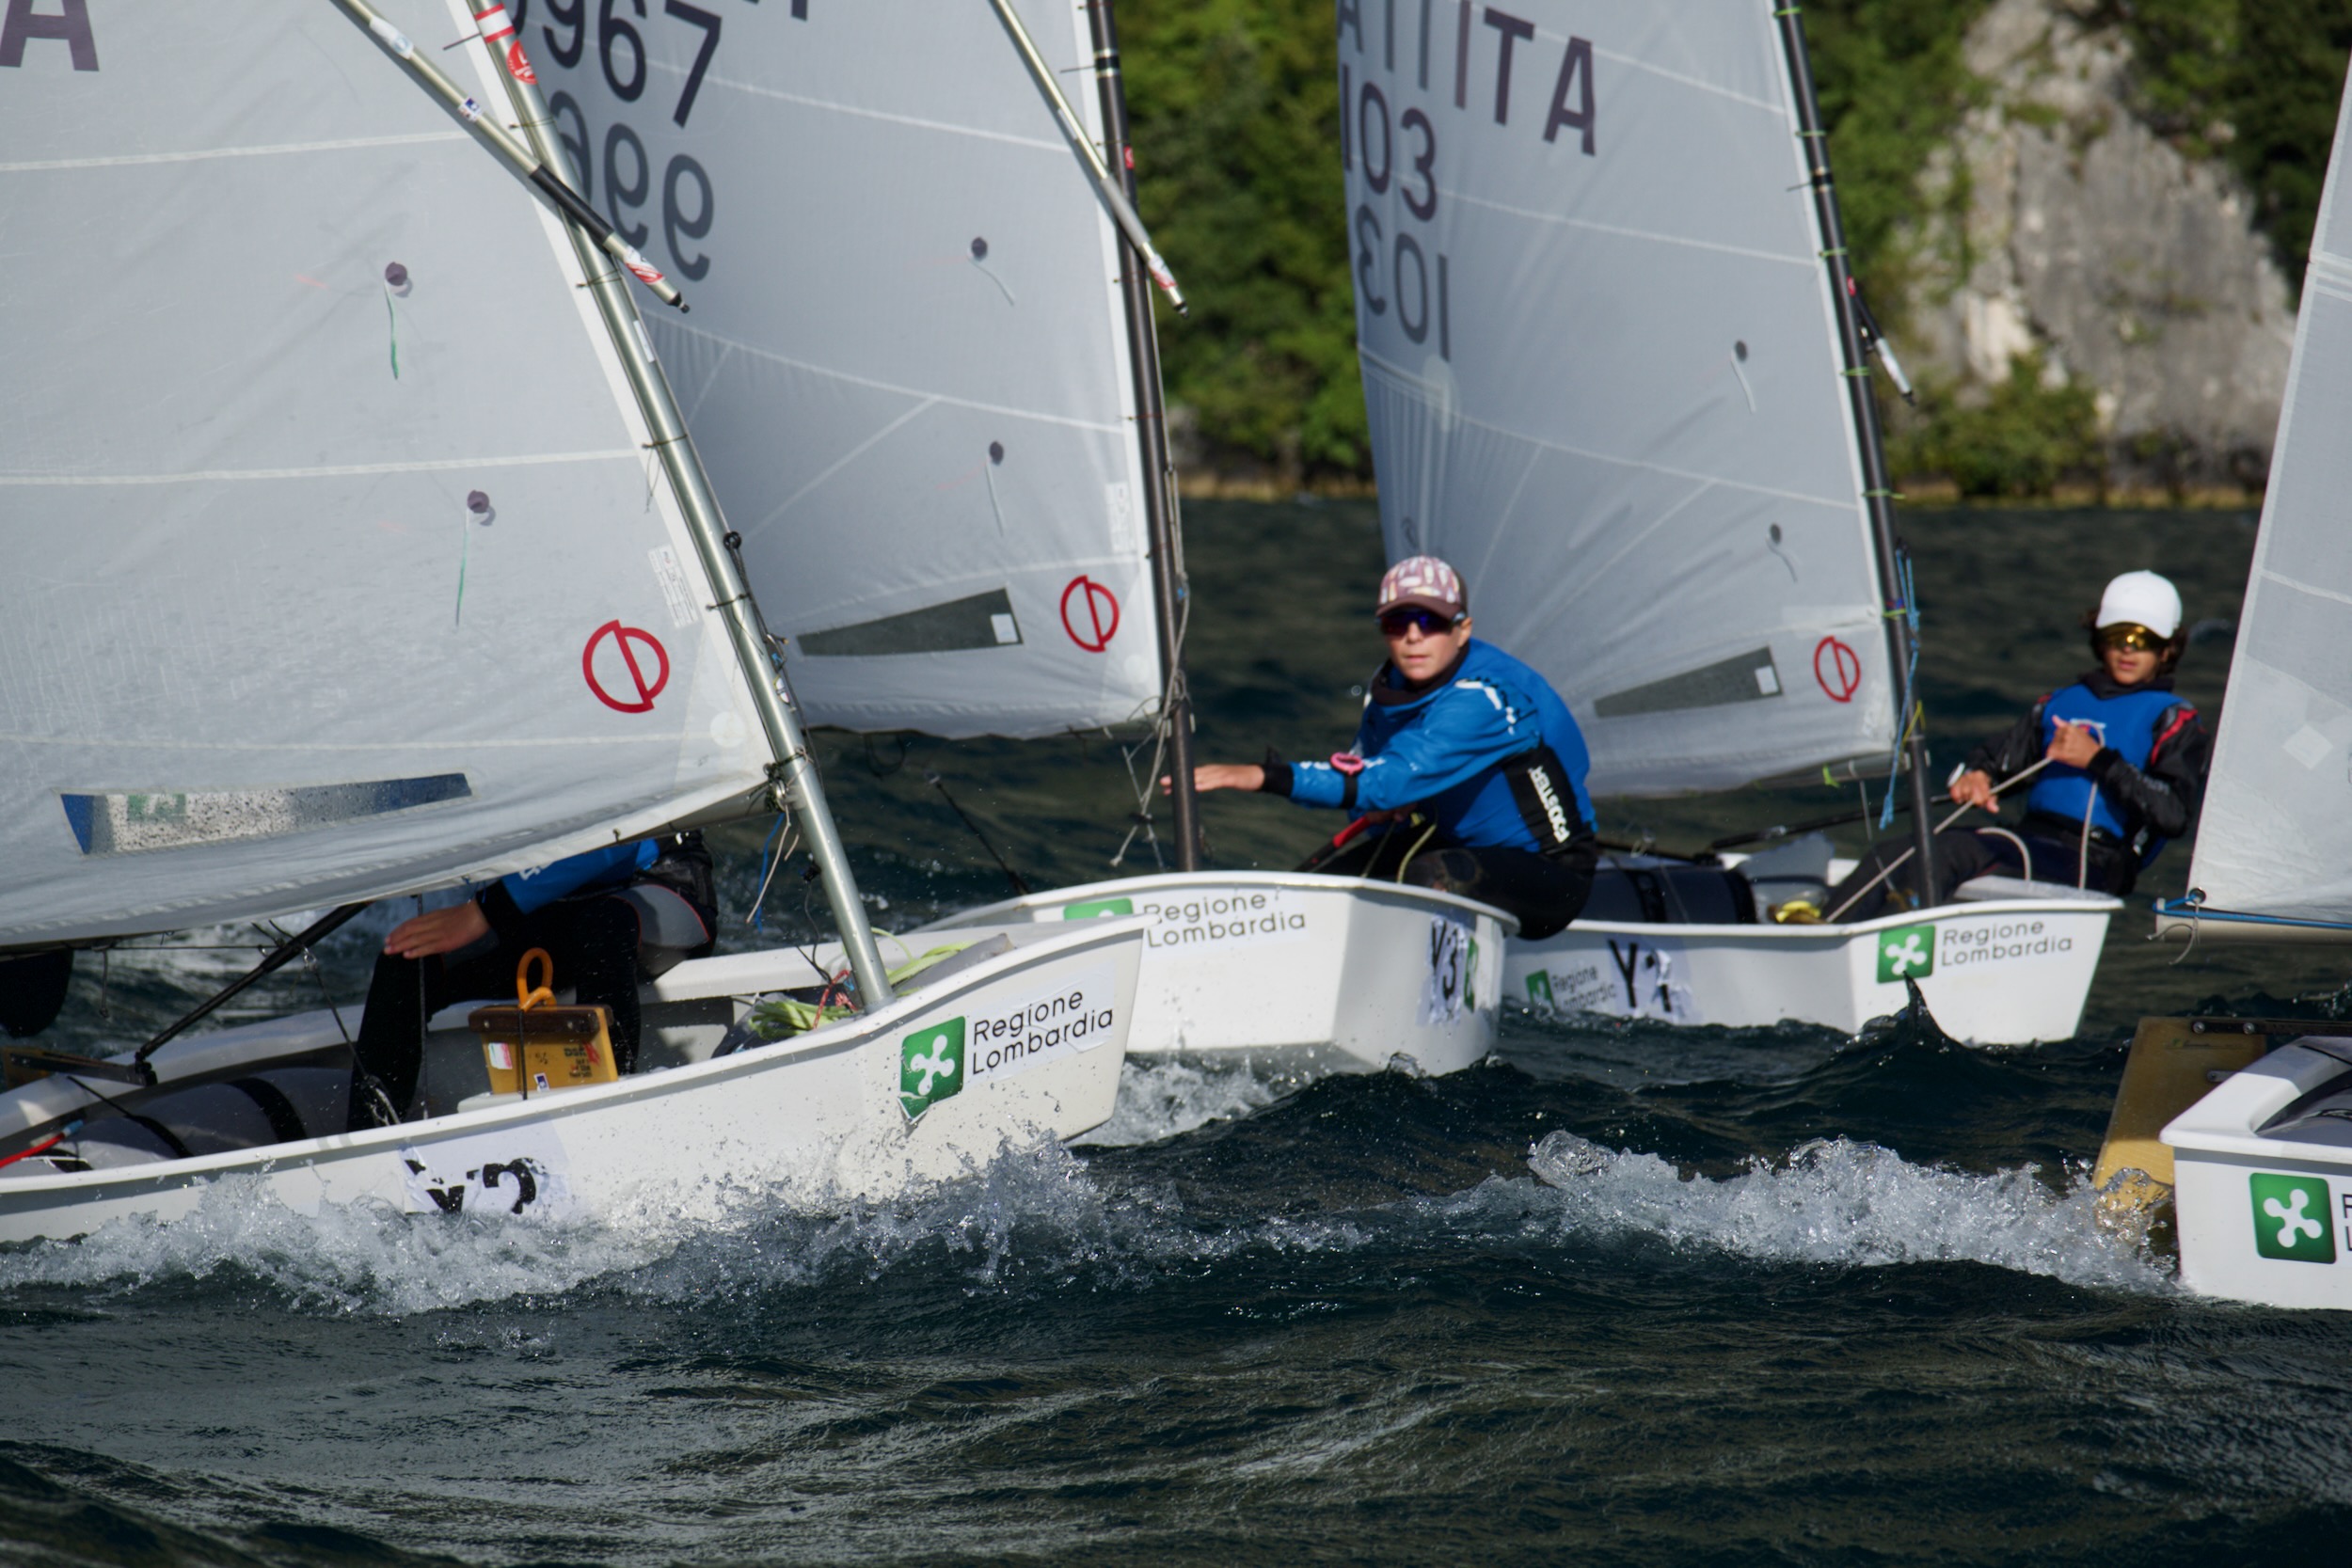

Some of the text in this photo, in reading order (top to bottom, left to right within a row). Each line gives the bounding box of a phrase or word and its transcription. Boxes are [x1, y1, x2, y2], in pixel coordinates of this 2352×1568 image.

[1454, 0, 1596, 157] ITA
[1143, 894, 1267, 923] Regione
[1147, 911, 1307, 948] Lombardia
[1943, 921, 2045, 946] Regione
[1941, 935, 2073, 967] Lombardia
[974, 990, 1083, 1046] Regione
[973, 1008, 1114, 1075] Lombardia
